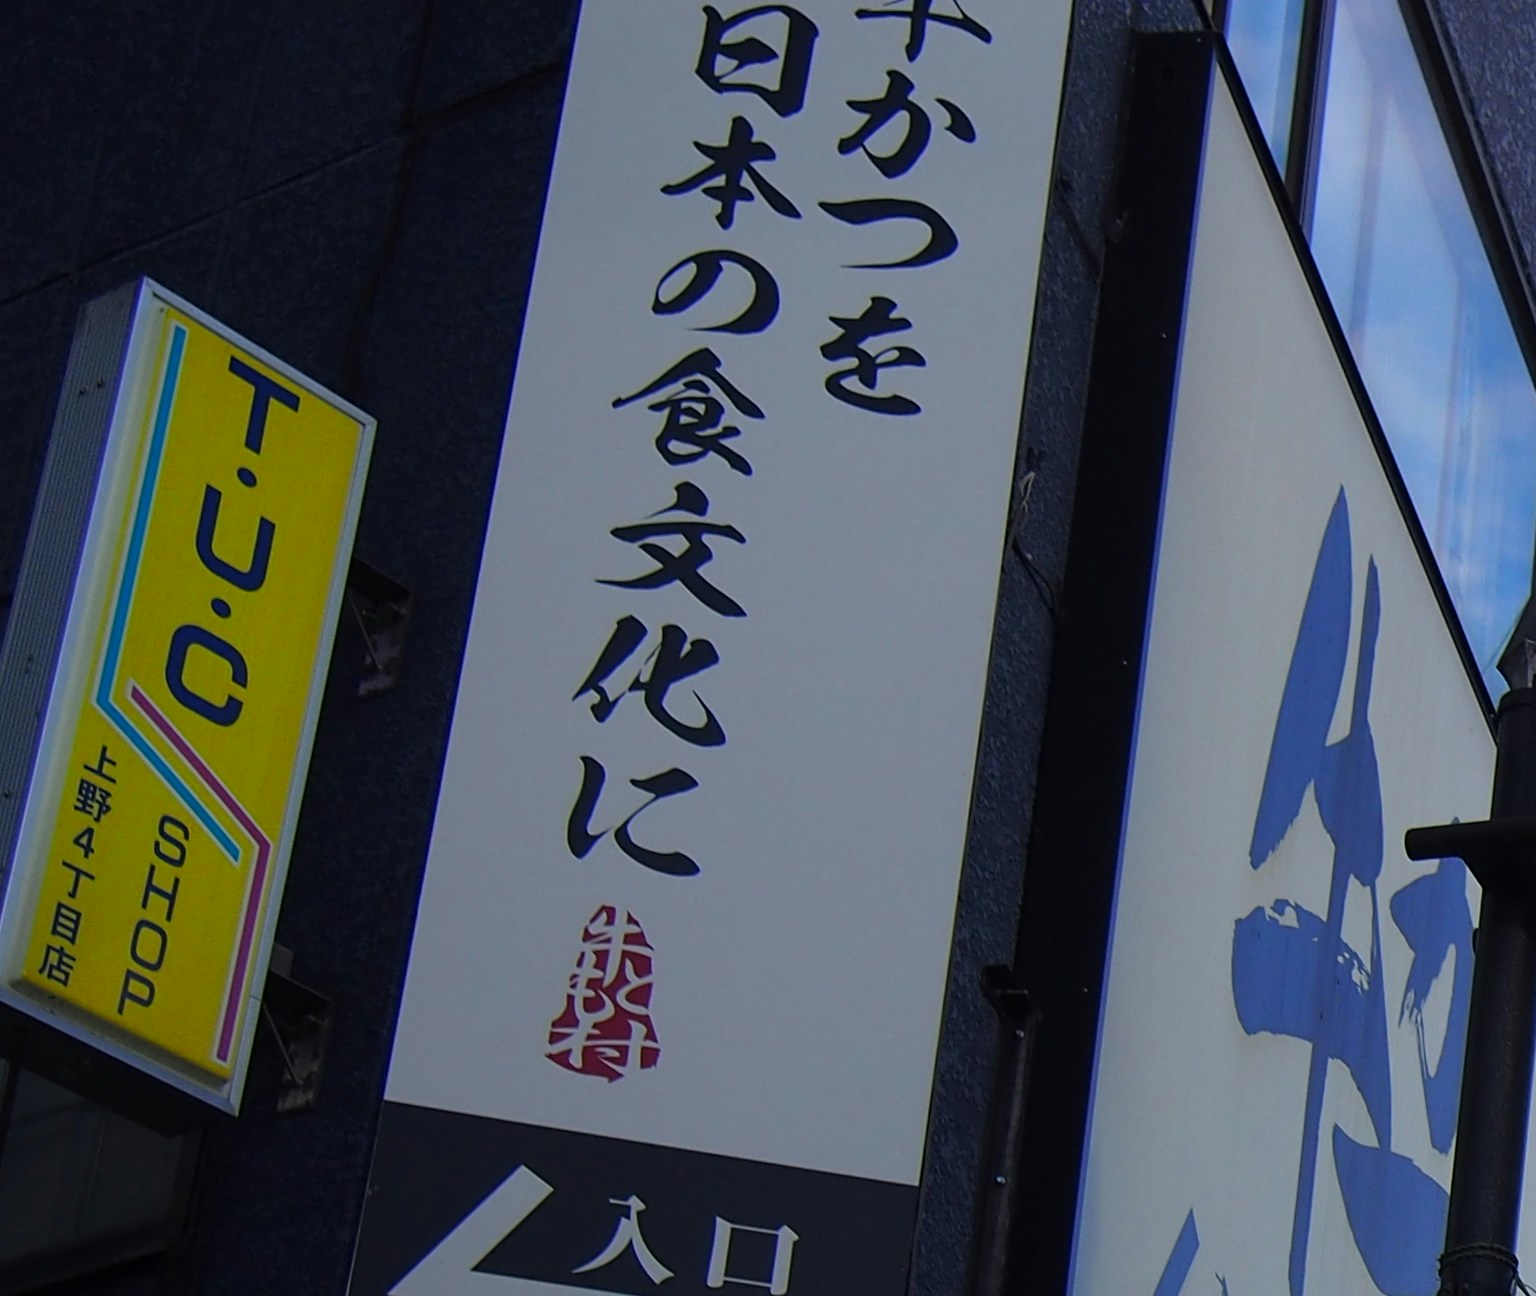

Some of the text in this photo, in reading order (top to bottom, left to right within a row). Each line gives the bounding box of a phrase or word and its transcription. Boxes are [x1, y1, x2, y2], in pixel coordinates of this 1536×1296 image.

[566, 4, 820, 877] 日本の食文化に
[38, 744, 118, 987] 上野4丁目店
[117, 813, 190, 1016] SHOP
[572, 1194, 800, 1296] 入口
